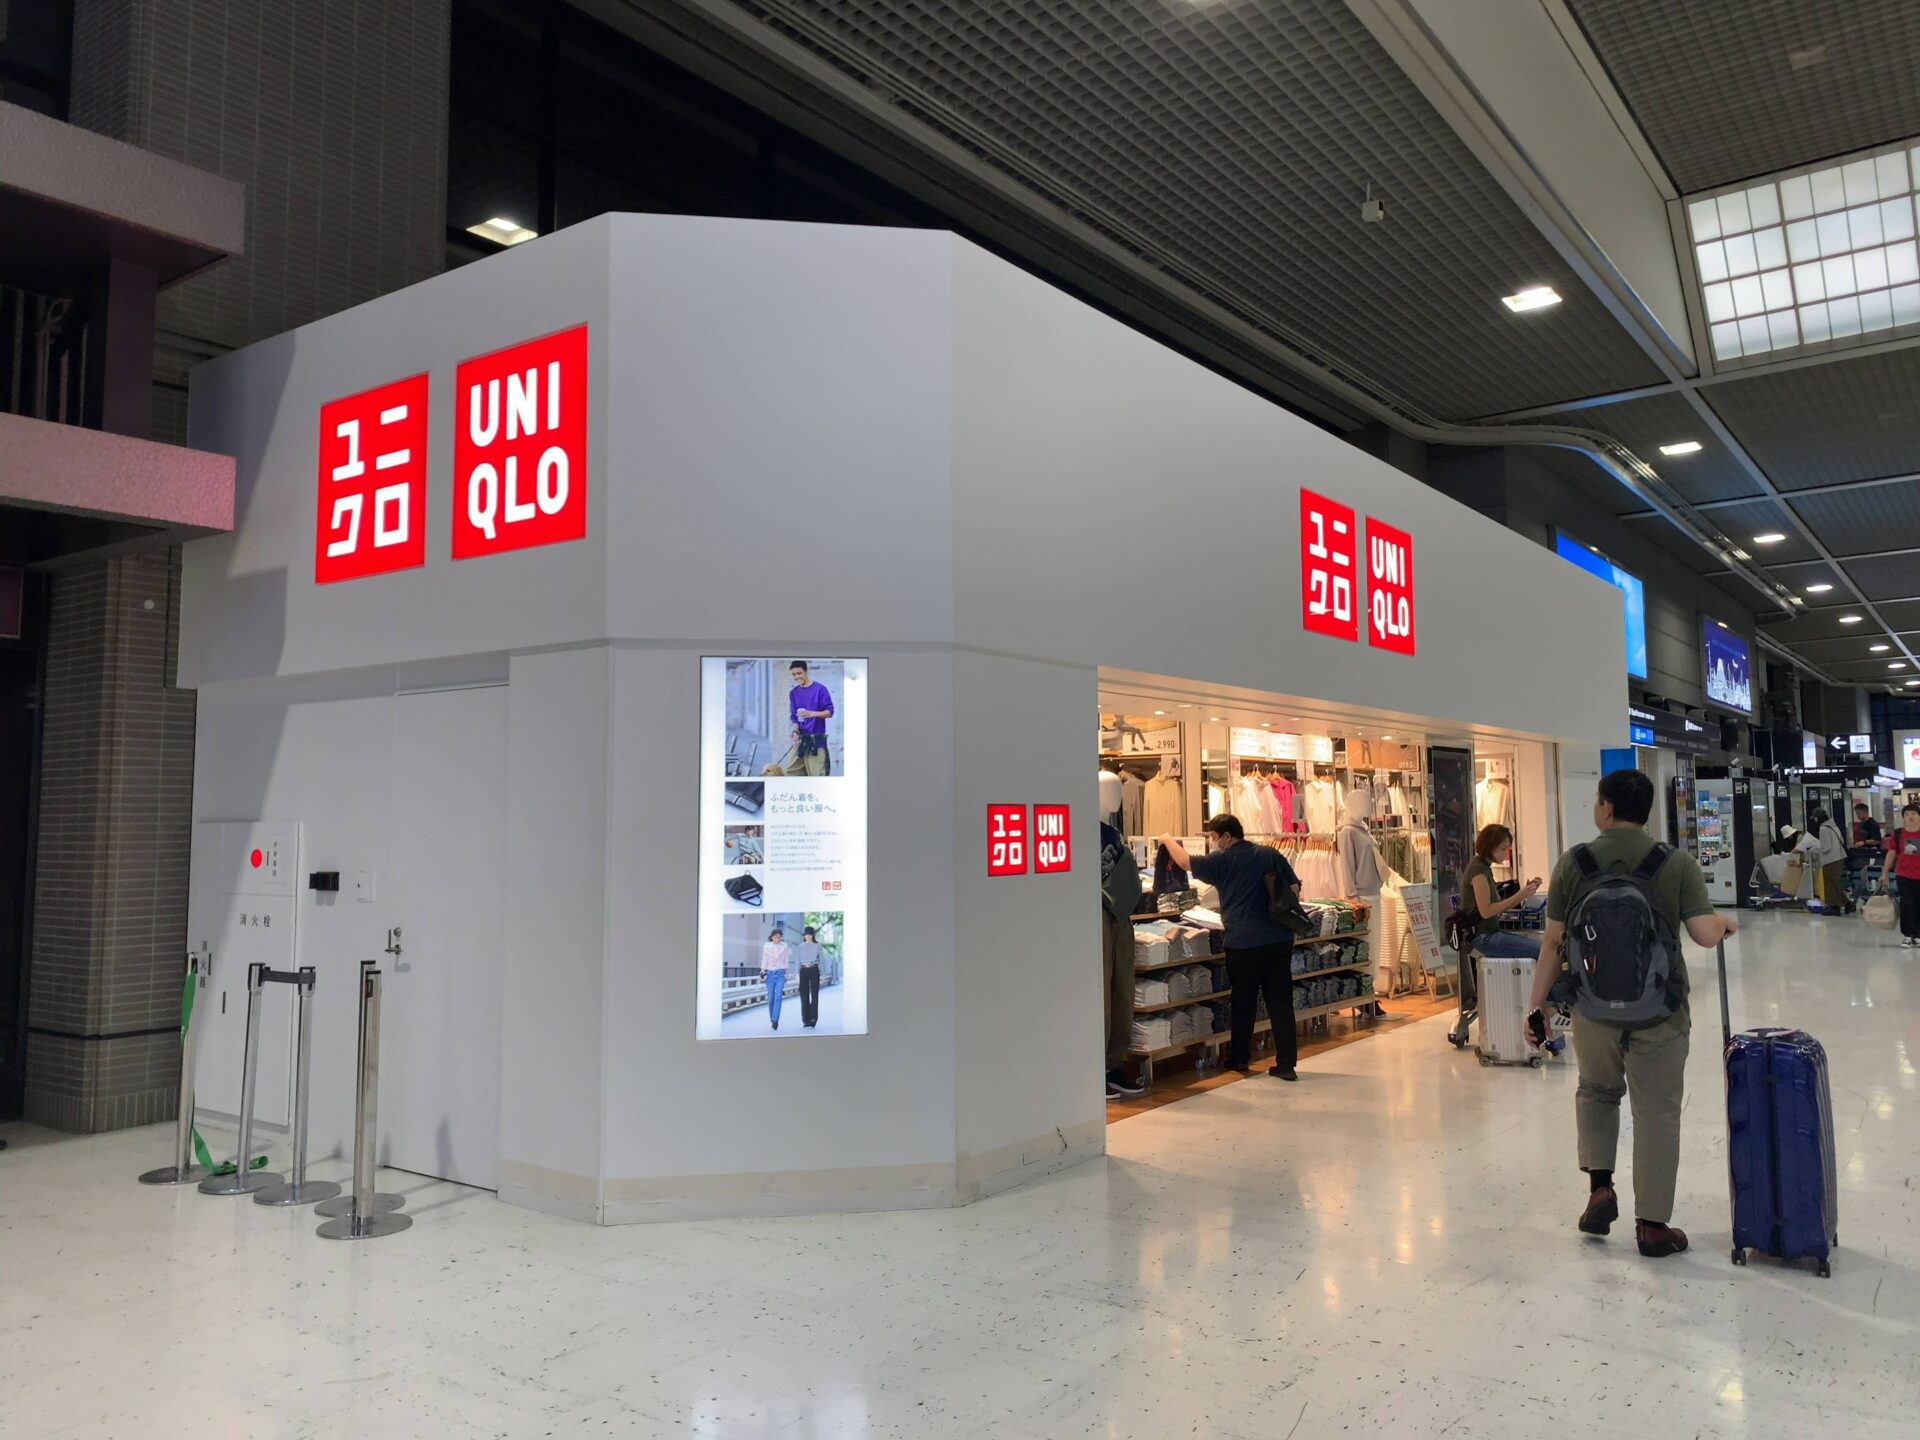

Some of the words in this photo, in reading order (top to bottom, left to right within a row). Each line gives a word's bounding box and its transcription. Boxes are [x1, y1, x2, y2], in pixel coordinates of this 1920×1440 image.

[469, 360, 560, 447] UNI
[332, 404, 411, 482] ユニ
[467, 445, 570, 540] QLO
[327, 482, 410, 558] クロ
[1309, 511, 1350, 566] ユニ
[1371, 535, 1406, 587] UNI
[1309, 568, 1351, 622] クロ
[1373, 588, 1410, 640] QLO
[770, 804, 837, 813] もっと良い服へ。
[993, 814, 1022, 837] ユニ
[1038, 814, 1064, 837] UNI
[992, 842, 1022, 867] クロ
[1038, 840, 1067, 868] QLO
[239, 913, 271, 928] 消火栓
